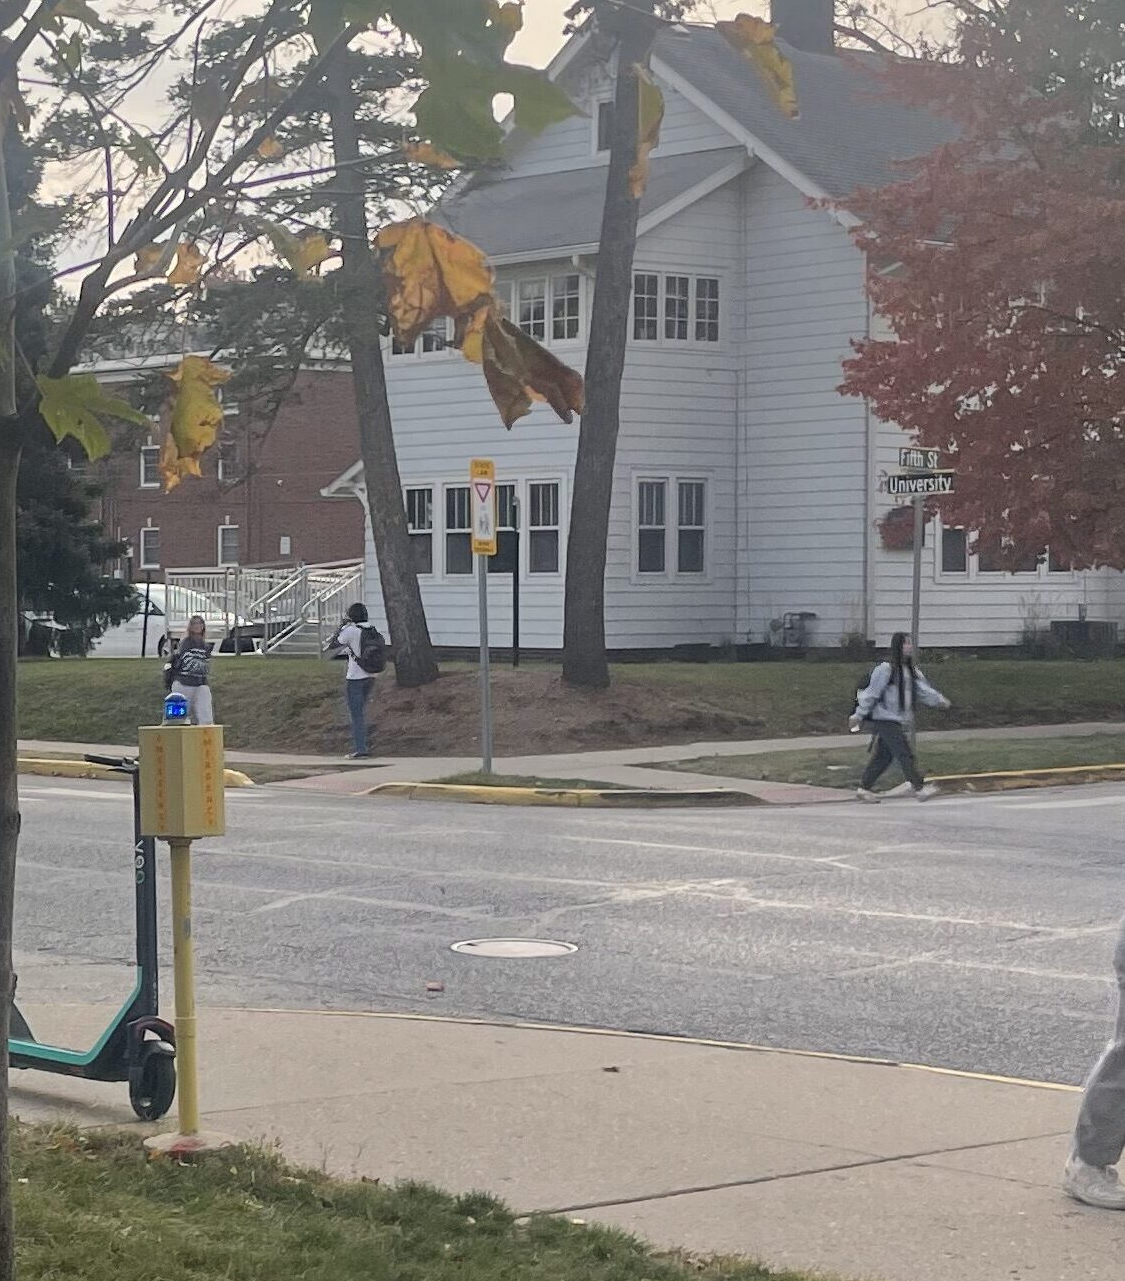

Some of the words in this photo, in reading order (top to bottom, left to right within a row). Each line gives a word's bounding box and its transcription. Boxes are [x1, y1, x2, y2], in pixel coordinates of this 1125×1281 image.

[900, 448, 924, 467] Fifth
[927, 451, 938, 468] St
[889, 474, 952, 494] University
